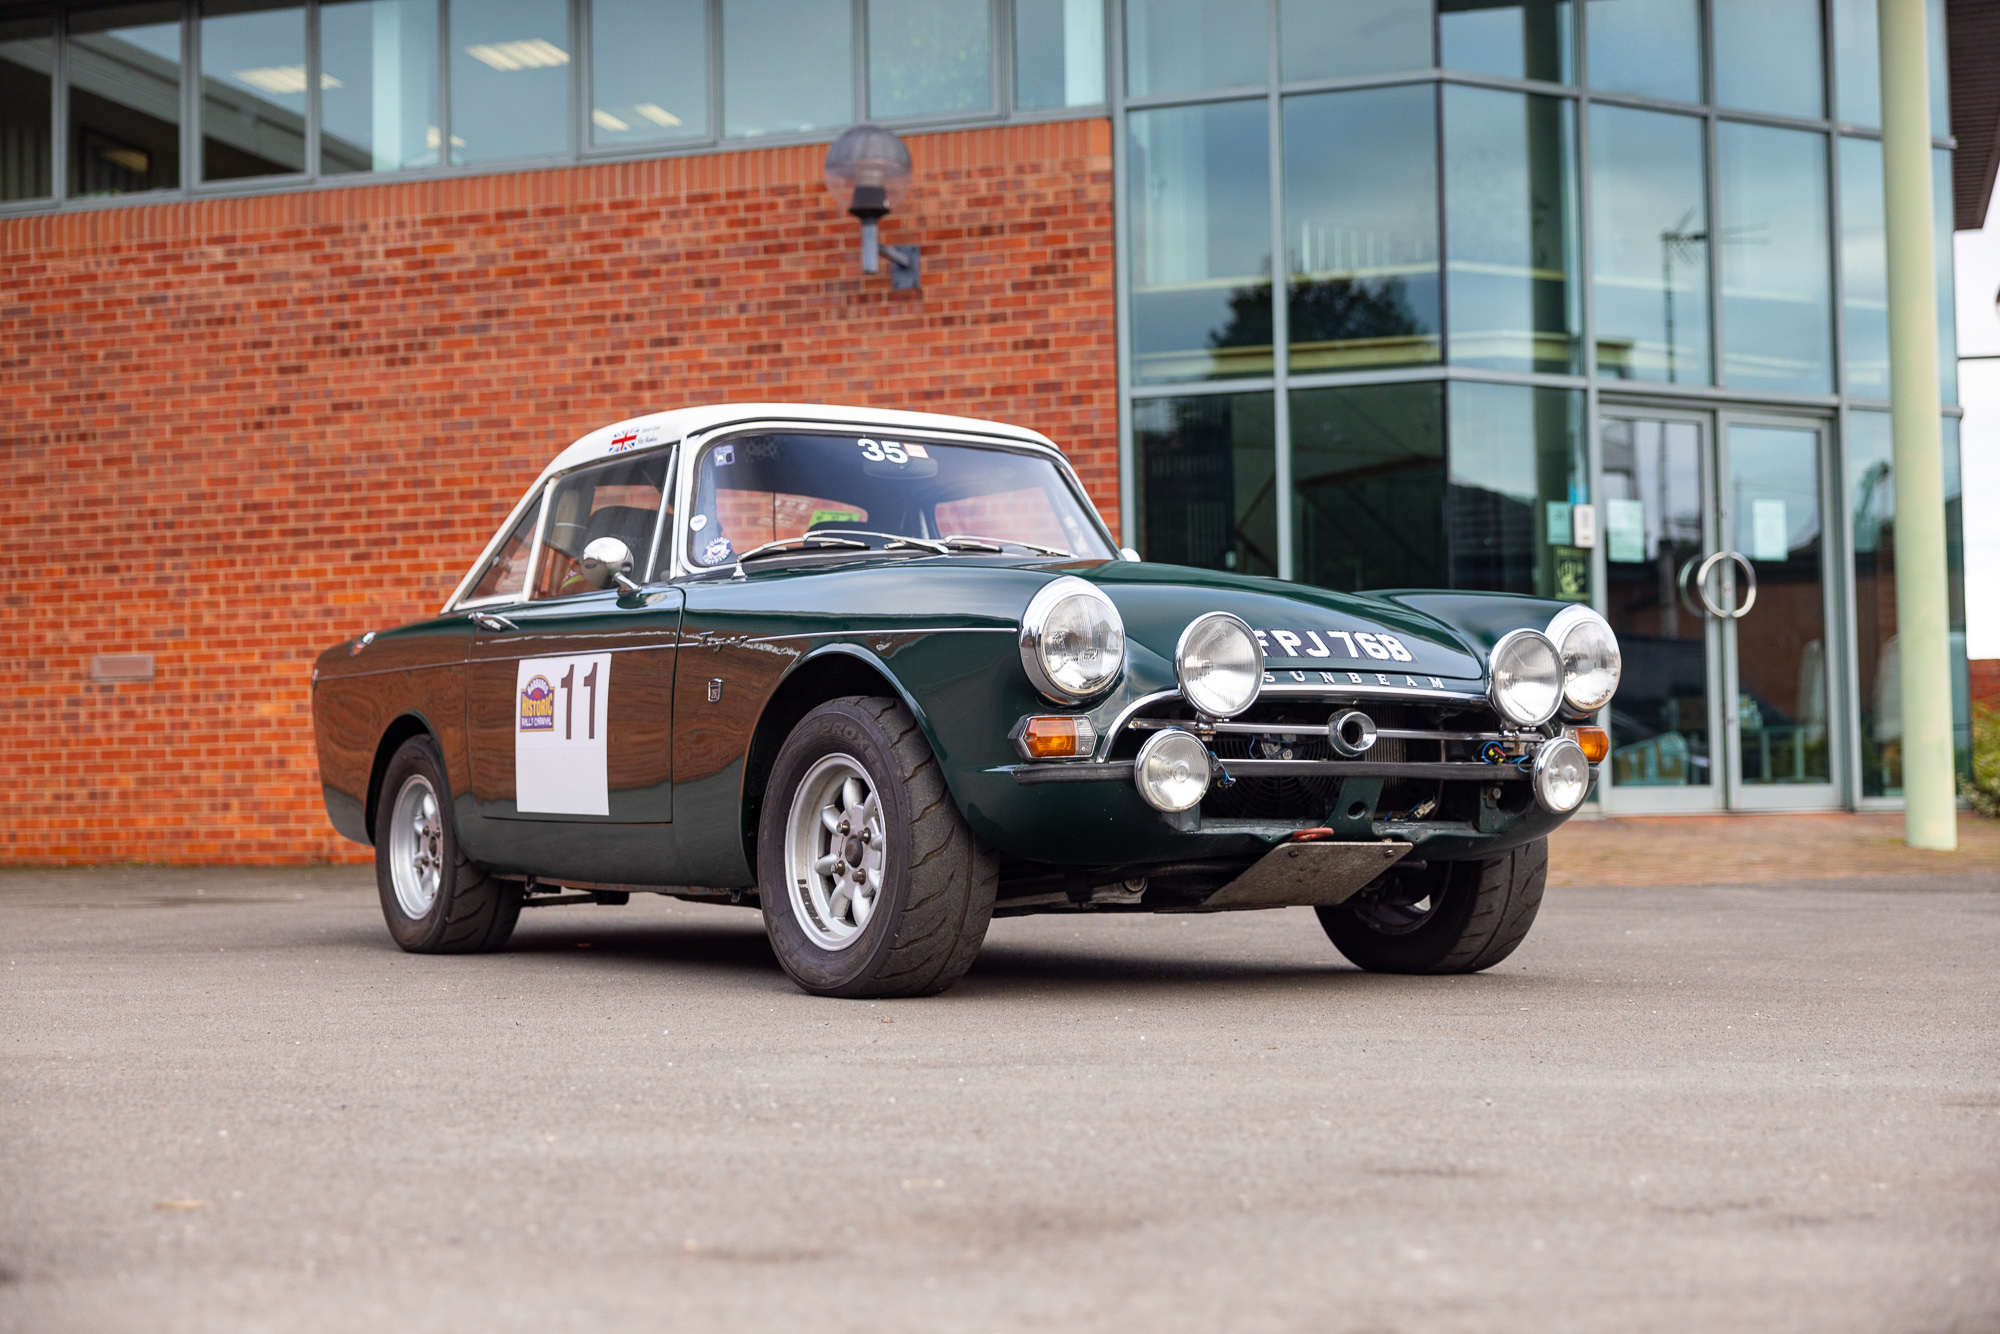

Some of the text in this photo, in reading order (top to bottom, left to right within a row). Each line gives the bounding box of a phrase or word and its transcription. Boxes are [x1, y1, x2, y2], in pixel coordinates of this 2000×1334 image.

[857, 438, 909, 464] 35
[1253, 630, 1413, 662] FPJ 76B
[1264, 670, 1445, 689] SUNBEAM
[521, 692, 553, 717] HISTORIC
[560, 662, 598, 740] 11
[521, 717, 534, 727] RALLY
[819, 720, 883, 780] PROXES
